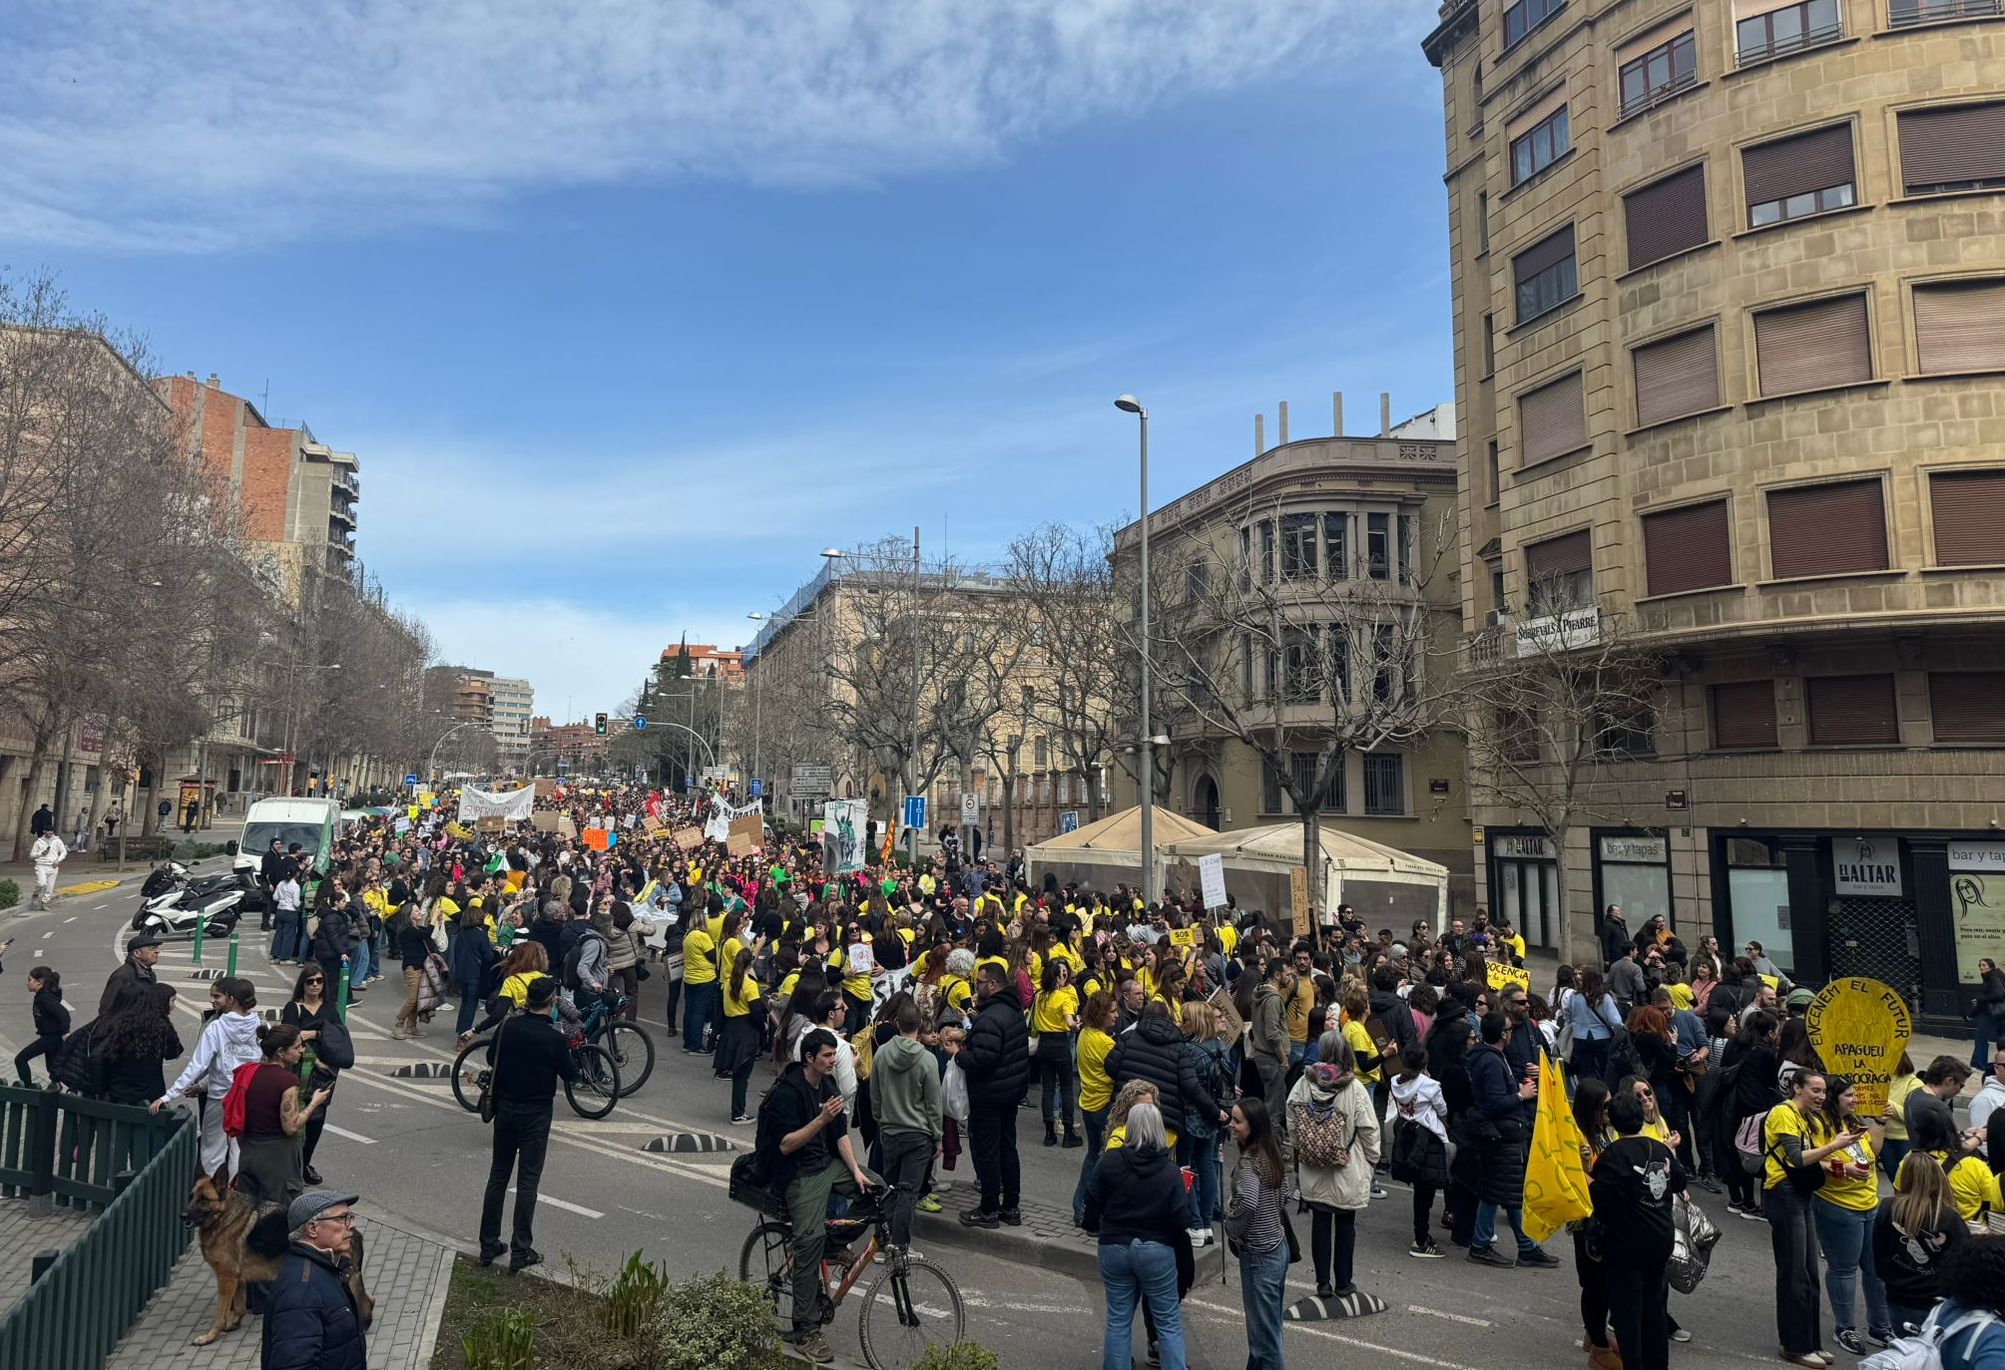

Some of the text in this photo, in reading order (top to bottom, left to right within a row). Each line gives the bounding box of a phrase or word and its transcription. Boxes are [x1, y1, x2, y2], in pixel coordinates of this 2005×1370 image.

[1522, 839, 1543, 855] ALTAR
[1622, 844, 1629, 857] y
[1632, 843, 1658, 858] tapas
[1952, 849, 1973, 860] bar
[1977, 851, 1985, 863] y
[1839, 864, 1896, 883] EL ALTAR
[1808, 980, 1909, 1046] ENCENEM EL FUTUR
[1834, 1043, 1884, 1057] APAGUEU
[1853, 1059, 1865, 1069] LA
